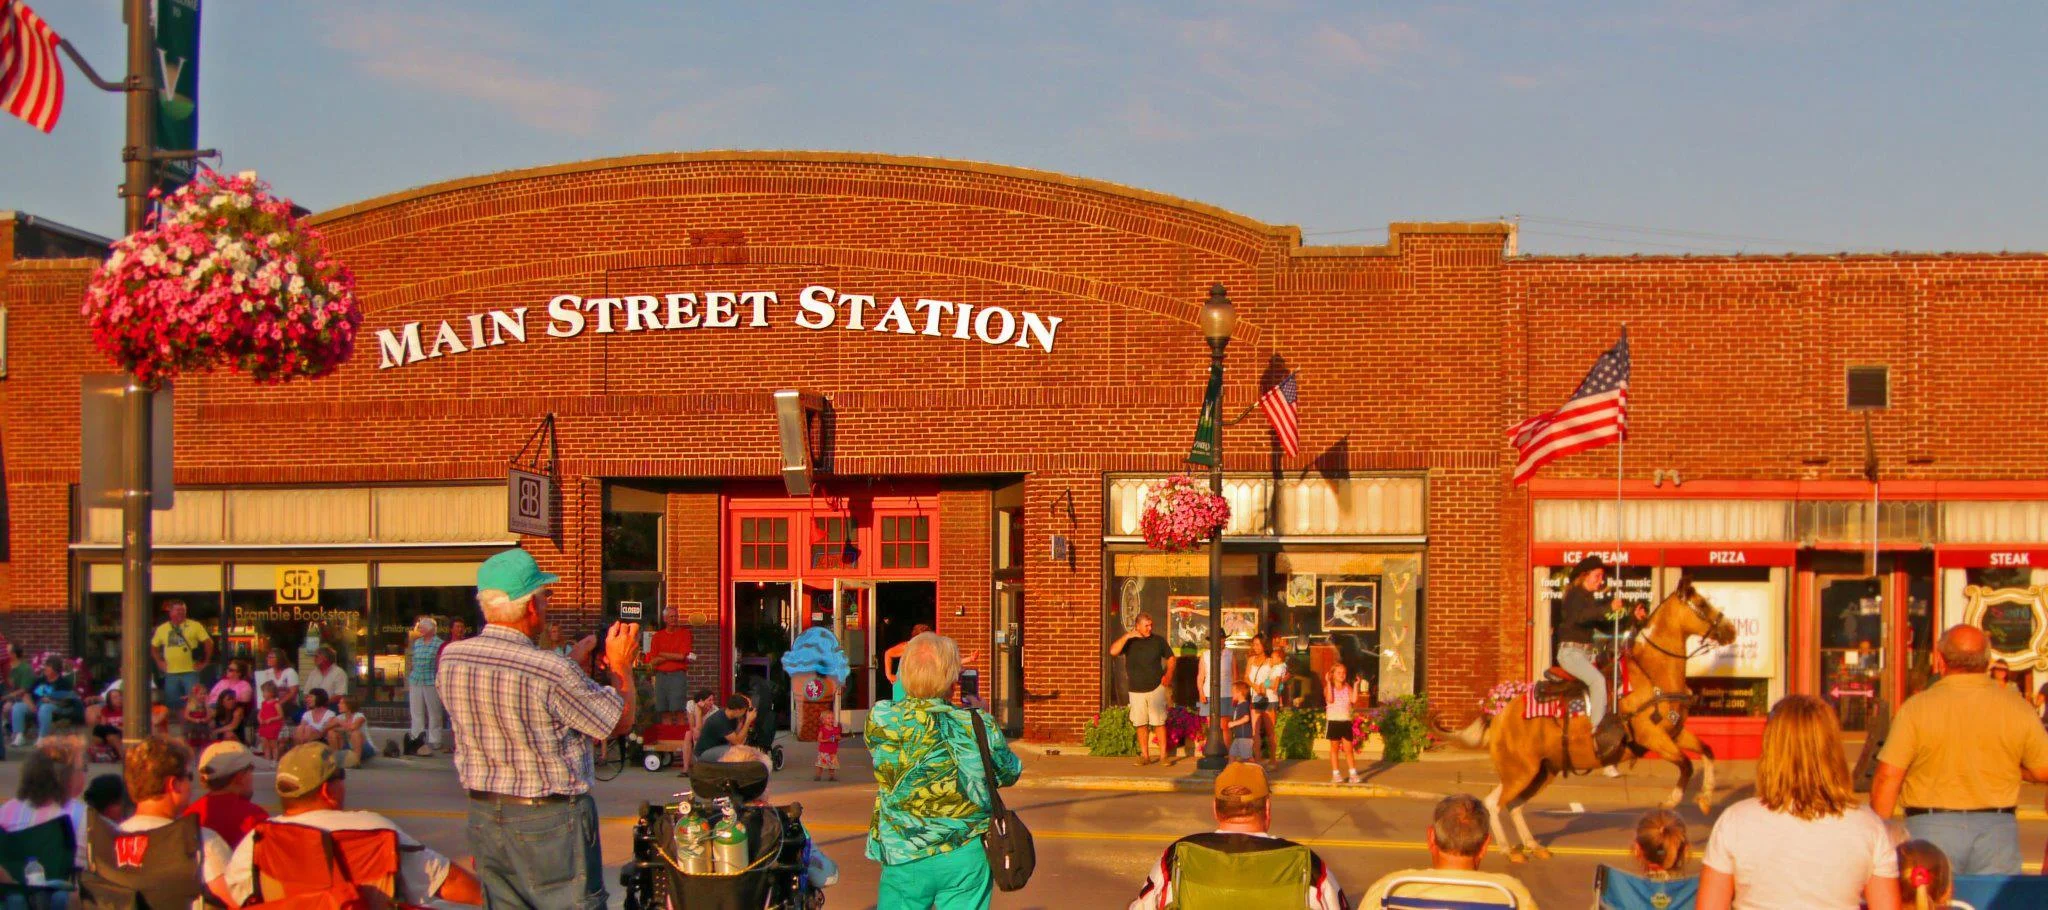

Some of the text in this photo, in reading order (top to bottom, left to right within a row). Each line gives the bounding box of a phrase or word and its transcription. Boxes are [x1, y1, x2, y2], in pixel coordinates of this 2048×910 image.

[376, 286, 1063, 370] MAIN STREET STATION
[1563, 551, 1583, 564] ICE
[1709, 551, 1746, 564] PIZZA
[1990, 552, 2030, 565] STEAK
[1541, 577, 1560, 587] food
[1625, 577, 1651, 587] music
[235, 606, 360, 620] Bramble Bookstore
[622, 606, 640, 614] CLOSED
[1726, 699, 1746, 709] 2010
[114, 835, 148, 868] W
